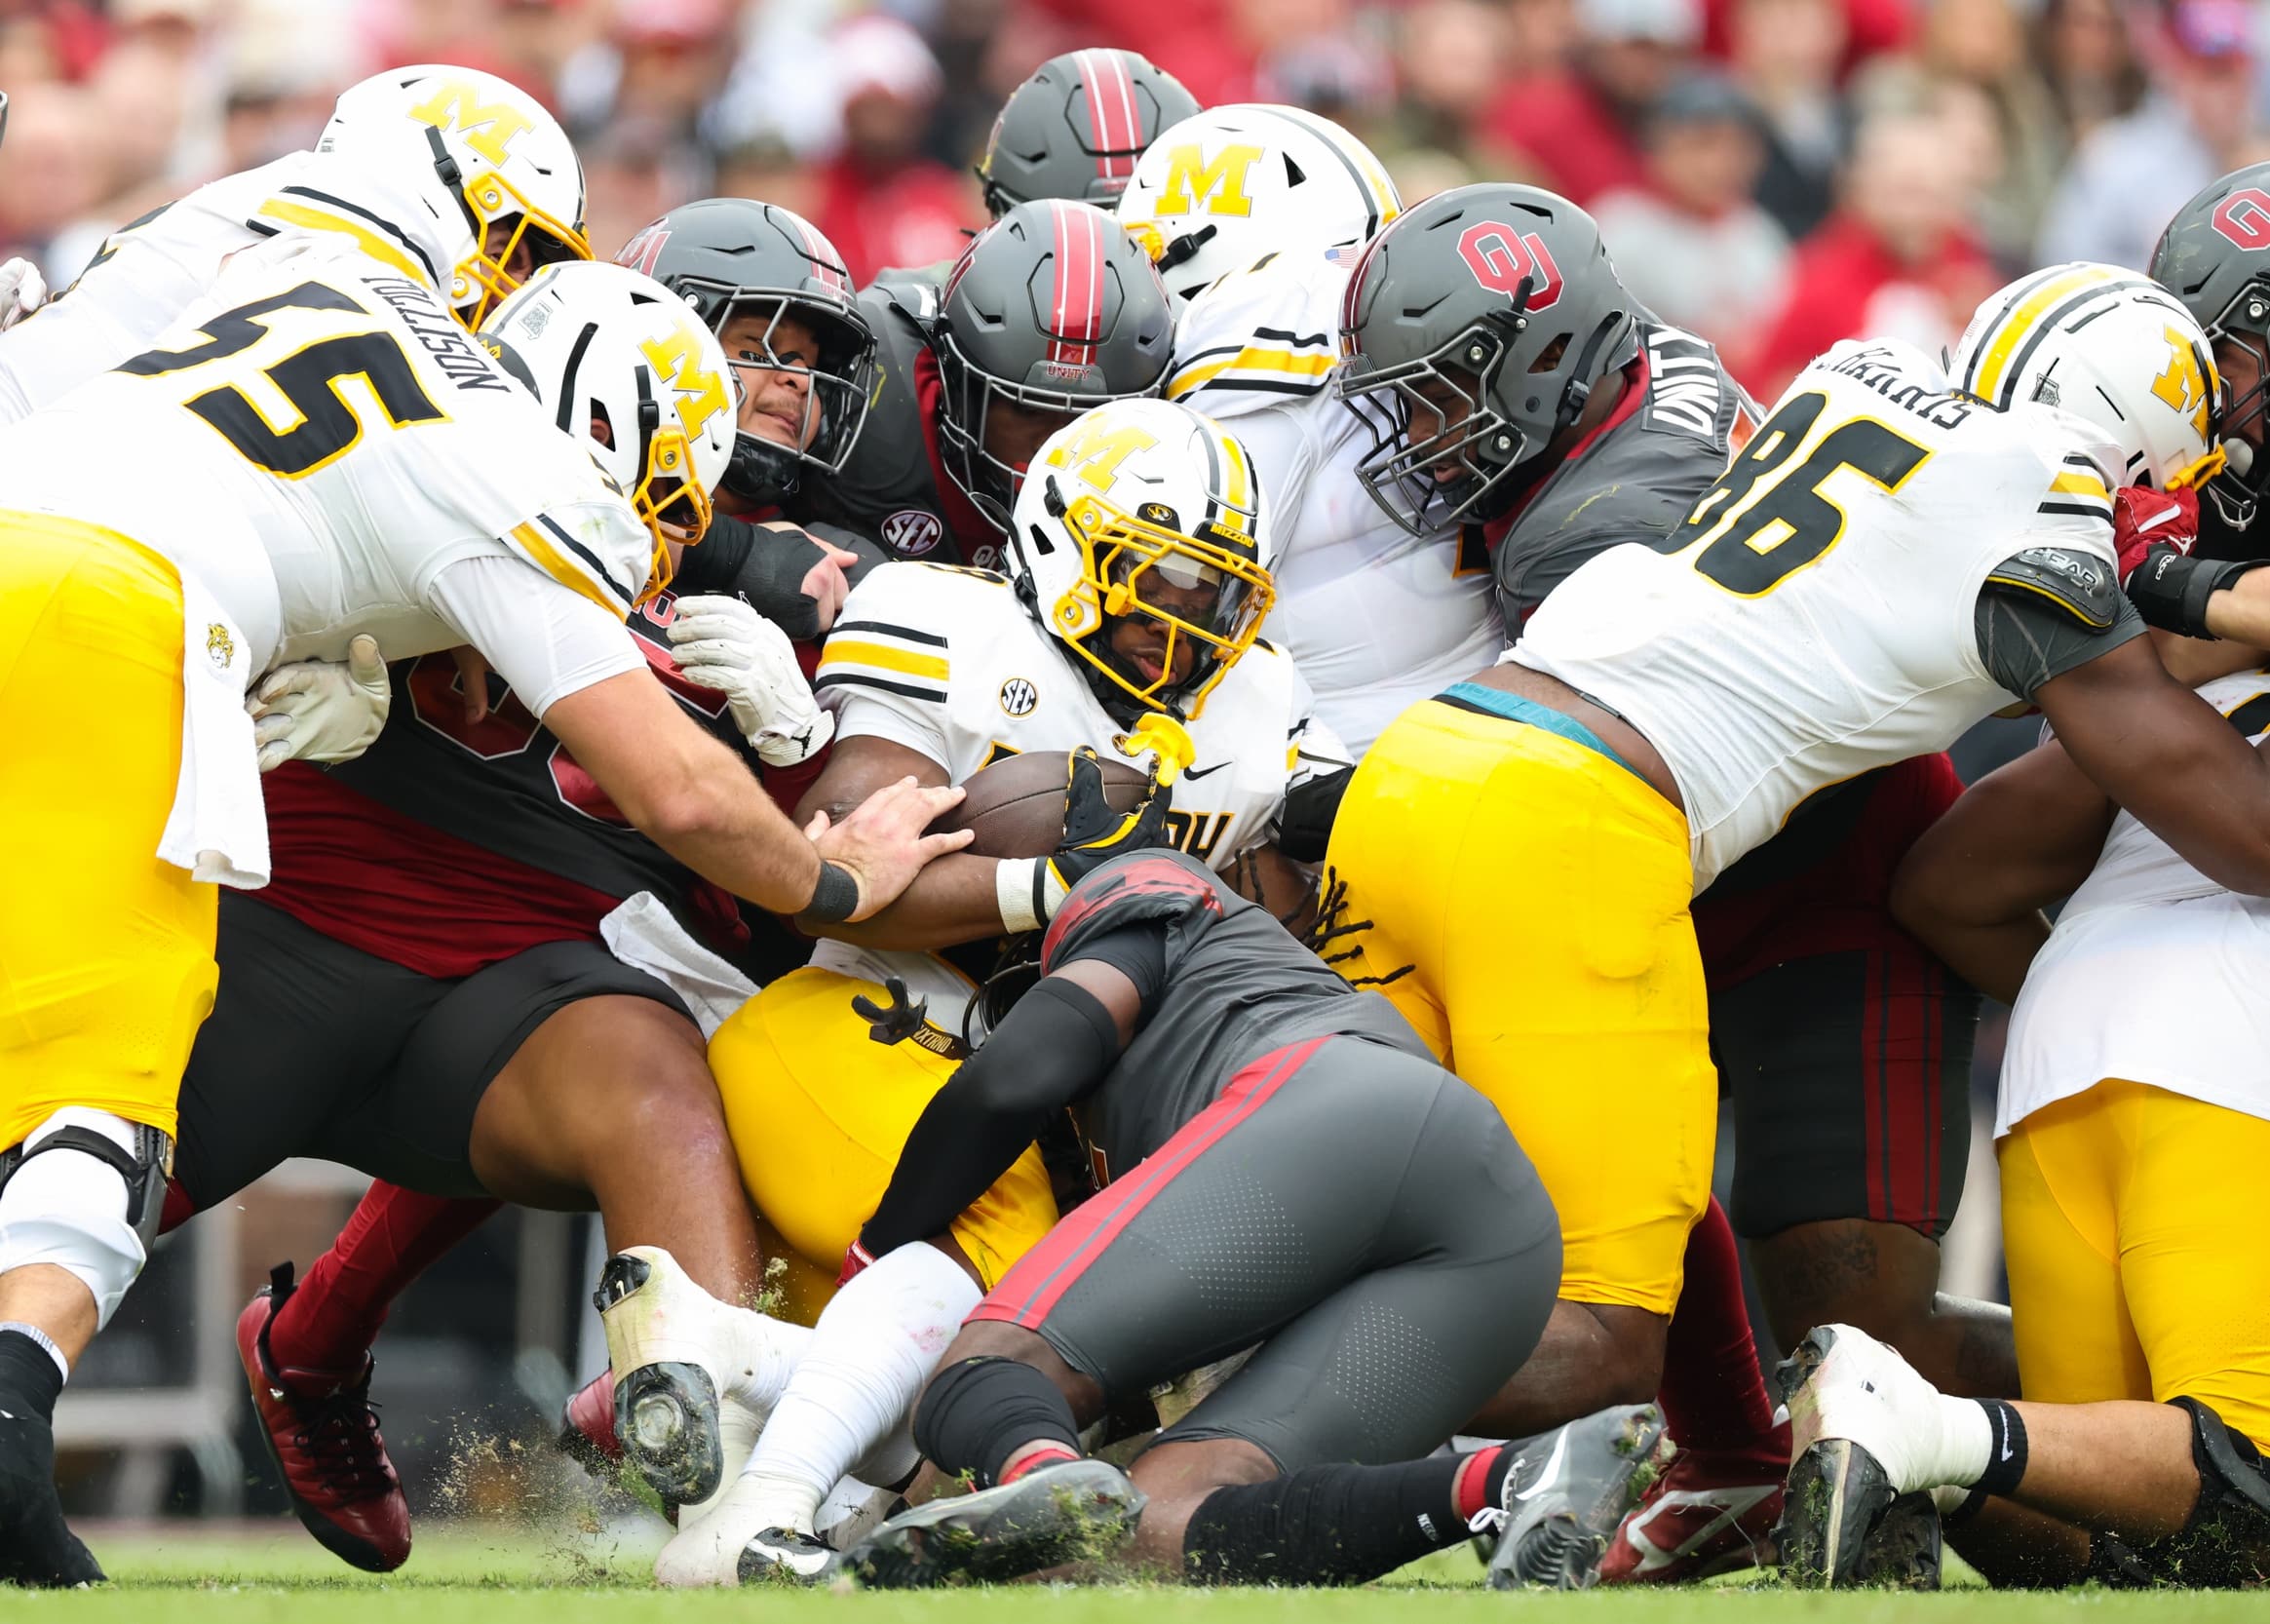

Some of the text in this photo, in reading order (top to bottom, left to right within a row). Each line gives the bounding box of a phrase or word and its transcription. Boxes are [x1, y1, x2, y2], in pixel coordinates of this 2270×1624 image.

[405, 78, 536, 169] M
[1154, 143, 1265, 218] M
[1457, 220, 1564, 314] OU
[360, 277, 512, 393] TOLLISON
[1047, 365, 1092, 379] UNITY
[108, 280, 451, 481] 55
[636, 317, 730, 444] M
[1045, 411, 1161, 494] M
[1655, 389, 1937, 599] 86
[882, 512, 941, 555] SEC
[1209, 522, 1254, 549] MIZZOU
[1000, 677, 1036, 715] SEC
